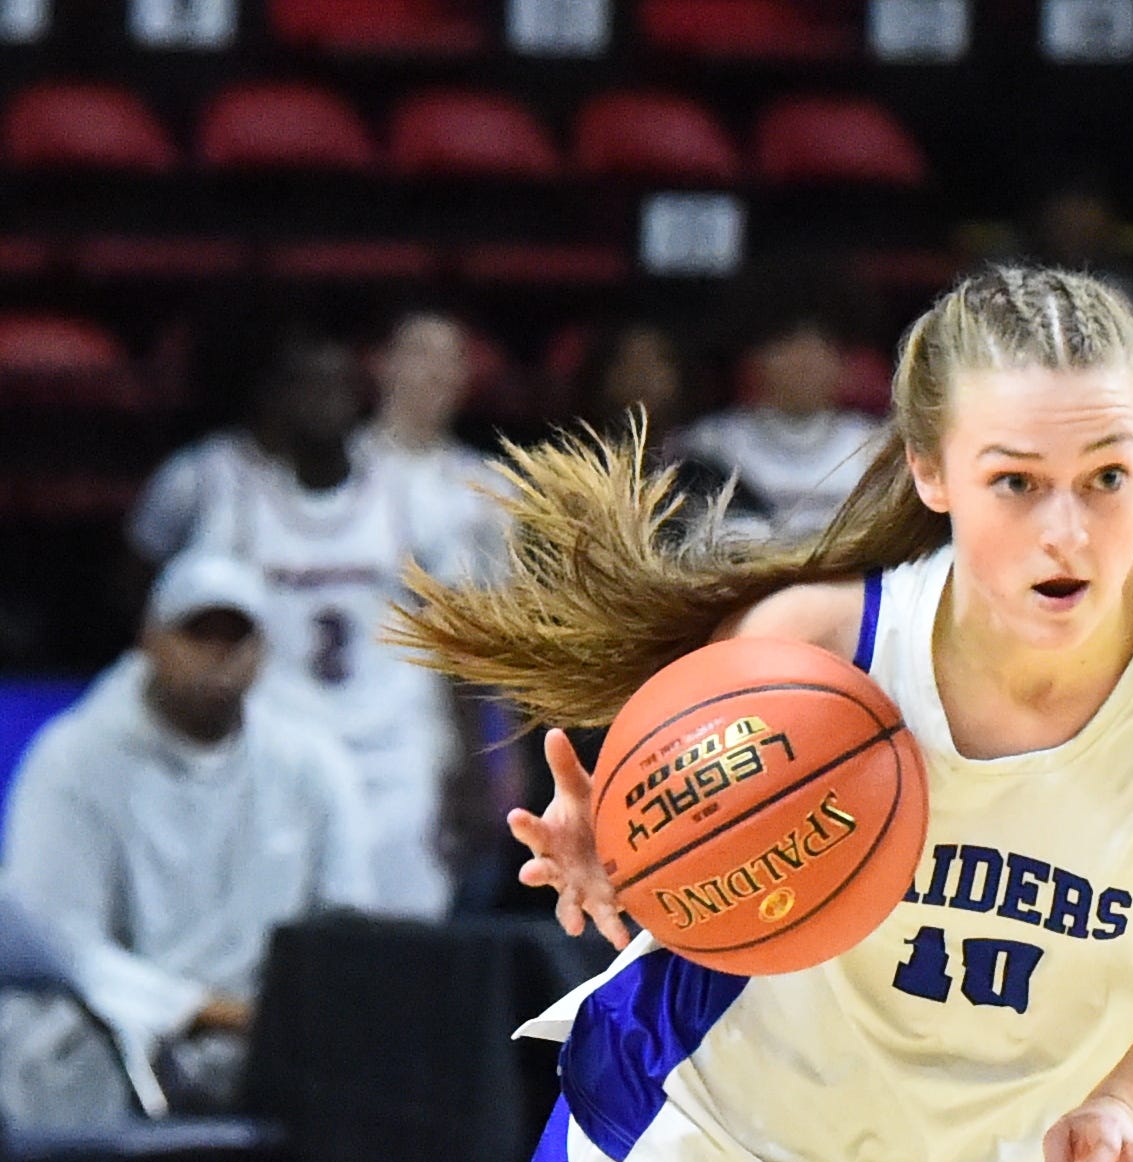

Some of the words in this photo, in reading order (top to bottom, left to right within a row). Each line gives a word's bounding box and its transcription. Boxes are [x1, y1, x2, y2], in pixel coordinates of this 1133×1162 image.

[627, 731, 795, 852] LEGACY
[653, 788, 857, 930] SPALDING
[900, 843, 1133, 940] IDERS
[892, 925, 1045, 1015] 10
